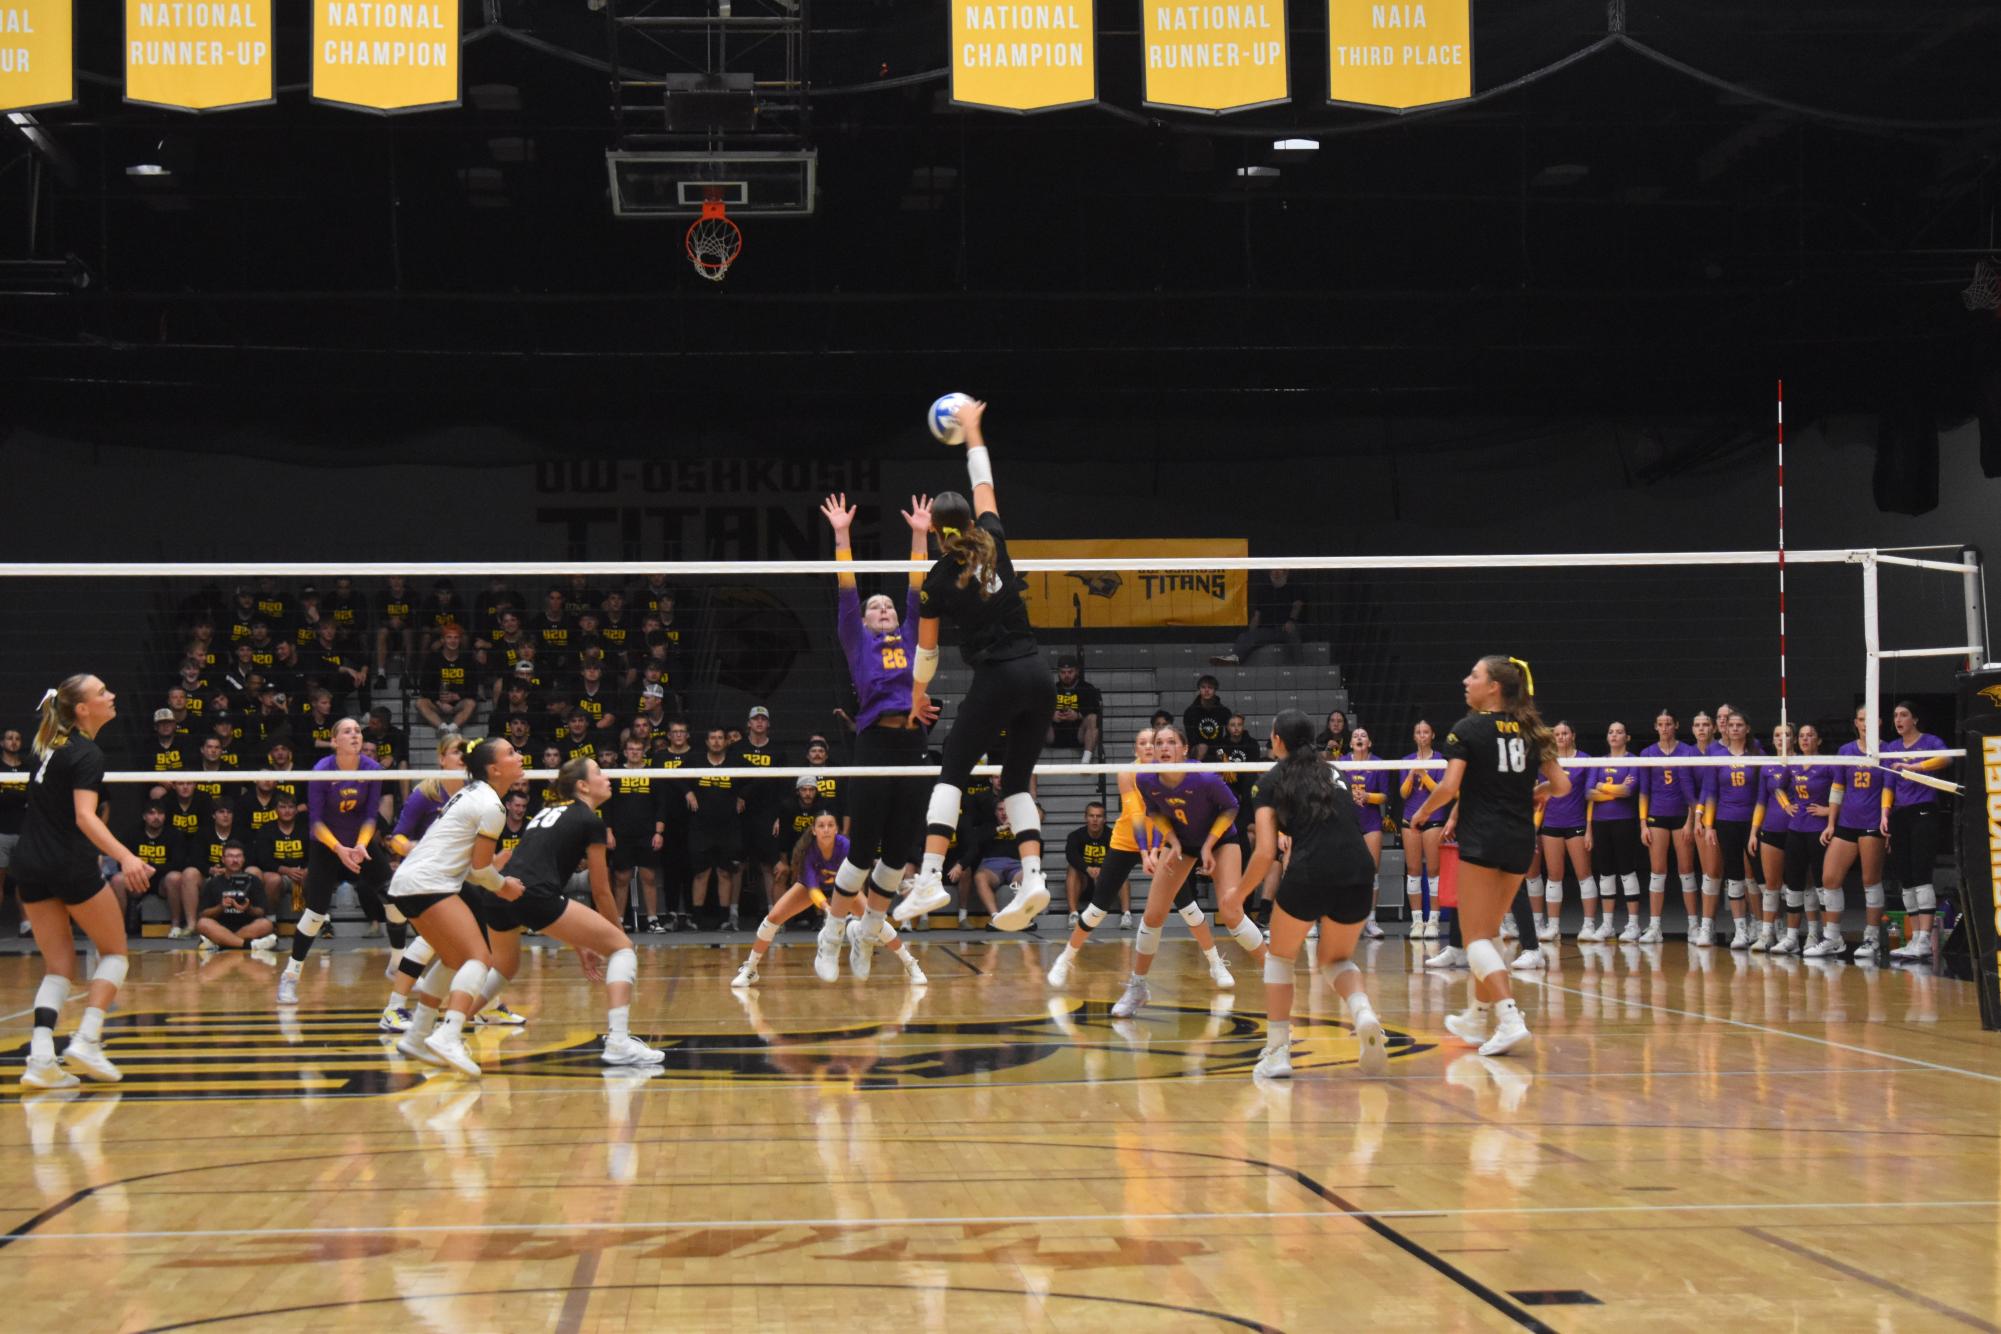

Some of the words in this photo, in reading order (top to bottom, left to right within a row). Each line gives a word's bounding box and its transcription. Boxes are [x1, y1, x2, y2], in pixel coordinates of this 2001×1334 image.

[0, 9, 34, 33] AL
[140, 2, 256, 28] NATIONAL
[328, 2, 444, 28] NATIONAL
[965, 4, 1080, 30] NATIONAL
[1157, 4, 1270, 31] NATIONAL
[1371, 4, 1426, 28] NAIA
[130, 40, 267, 66] RUNNER-UP
[323, 40, 447, 66] CHAMPION
[963, 42, 1083, 68] CHAMPION
[1150, 41, 1281, 69] RUNNER-UP
[1338, 45, 1394, 66] THIRD
[1402, 44, 1462, 65] PLACE
[536, 458, 880, 493] UW-OSHKOSH
[1139, 574, 1226, 600] TITANS
[881, 647, 909, 670] 26
[1496, 737, 1526, 773] 18
[1663, 769, 1673, 785] 5
[1854, 771, 1871, 788] 23
[1795, 785, 1809, 800] 15
[526, 806, 568, 829] 26
[138, 844, 166, 858] 920
[274, 839, 303, 852] 920
[503, 839, 522, 850] 92
